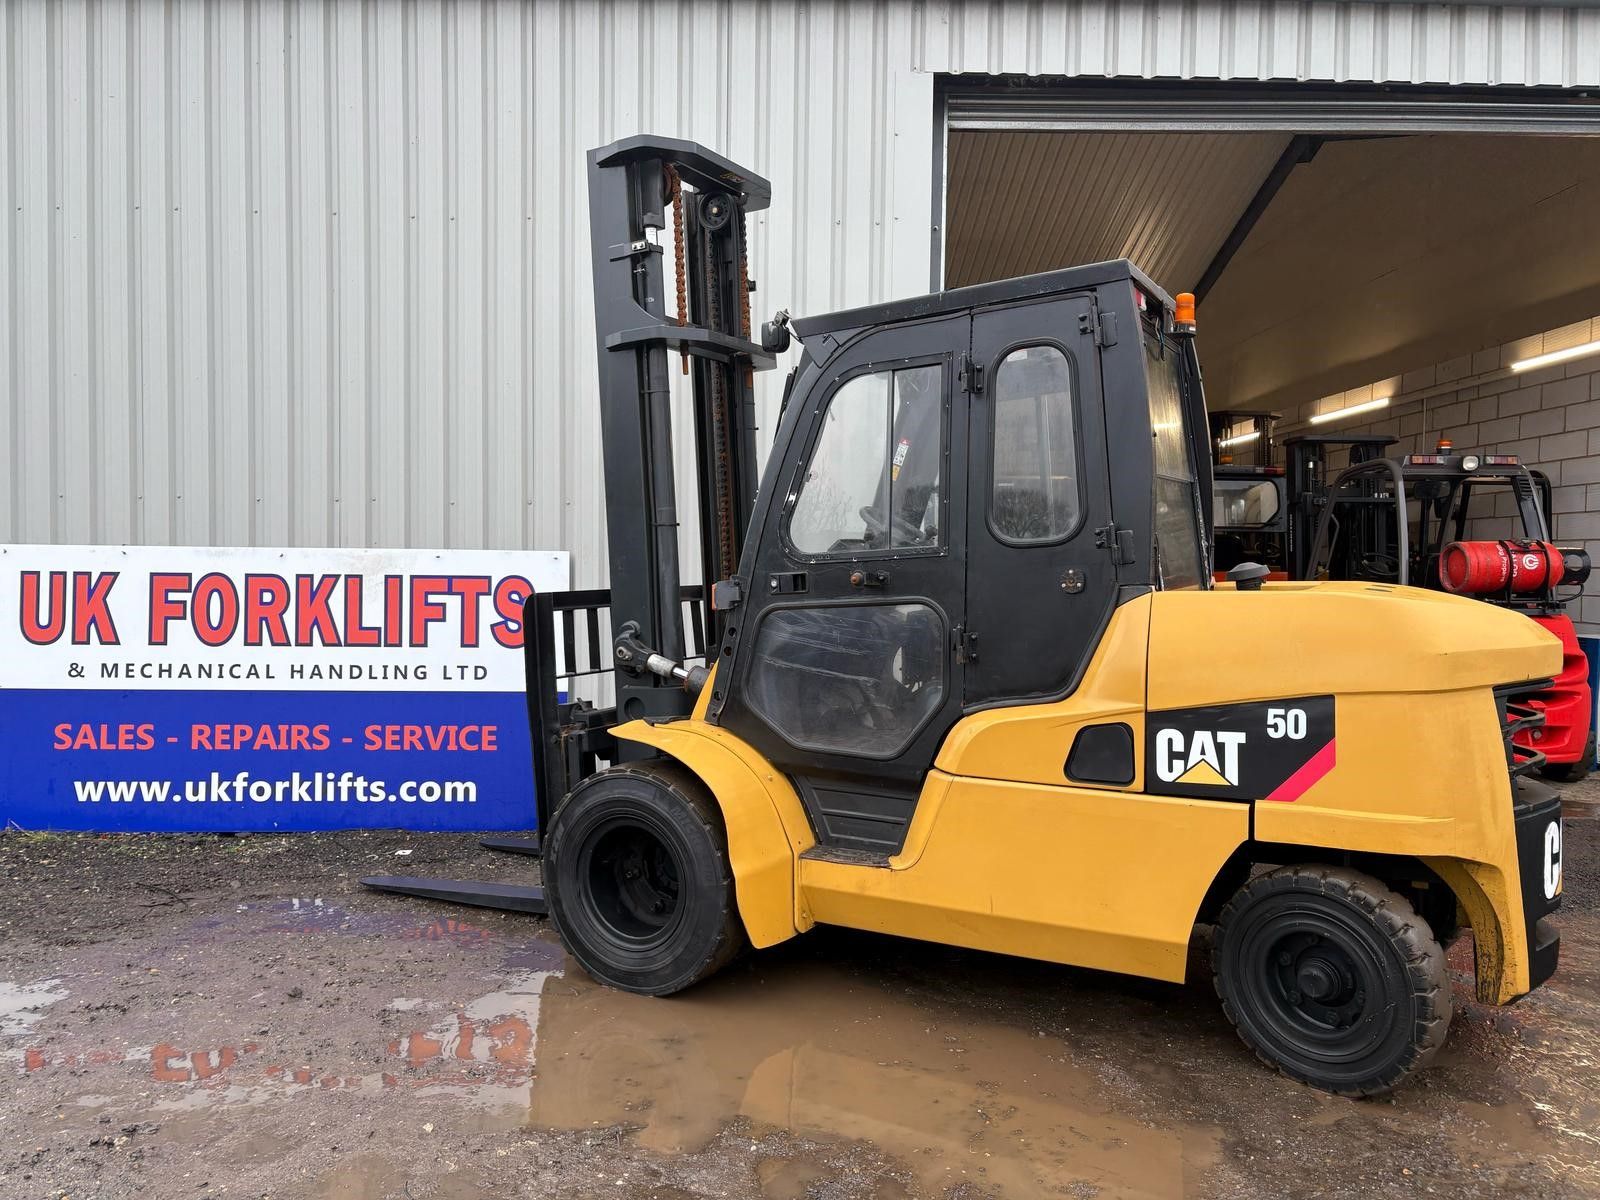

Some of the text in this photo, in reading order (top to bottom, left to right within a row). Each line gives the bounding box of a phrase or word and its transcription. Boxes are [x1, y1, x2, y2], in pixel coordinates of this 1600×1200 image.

[20, 571, 534, 648] UK FORKLIFTS
[68, 663, 488, 680] & MECHANICAL HANDLING LTD
[54, 724, 154, 750] SALES
[191, 725, 329, 750] REPAIRS
[365, 725, 497, 751] SERVICE
[1267, 708, 1307, 739] 50
[1156, 728, 1246, 786] CAT
[74, 772, 477, 803] www.ukforklifts.com
[1543, 821, 1562, 899] C
